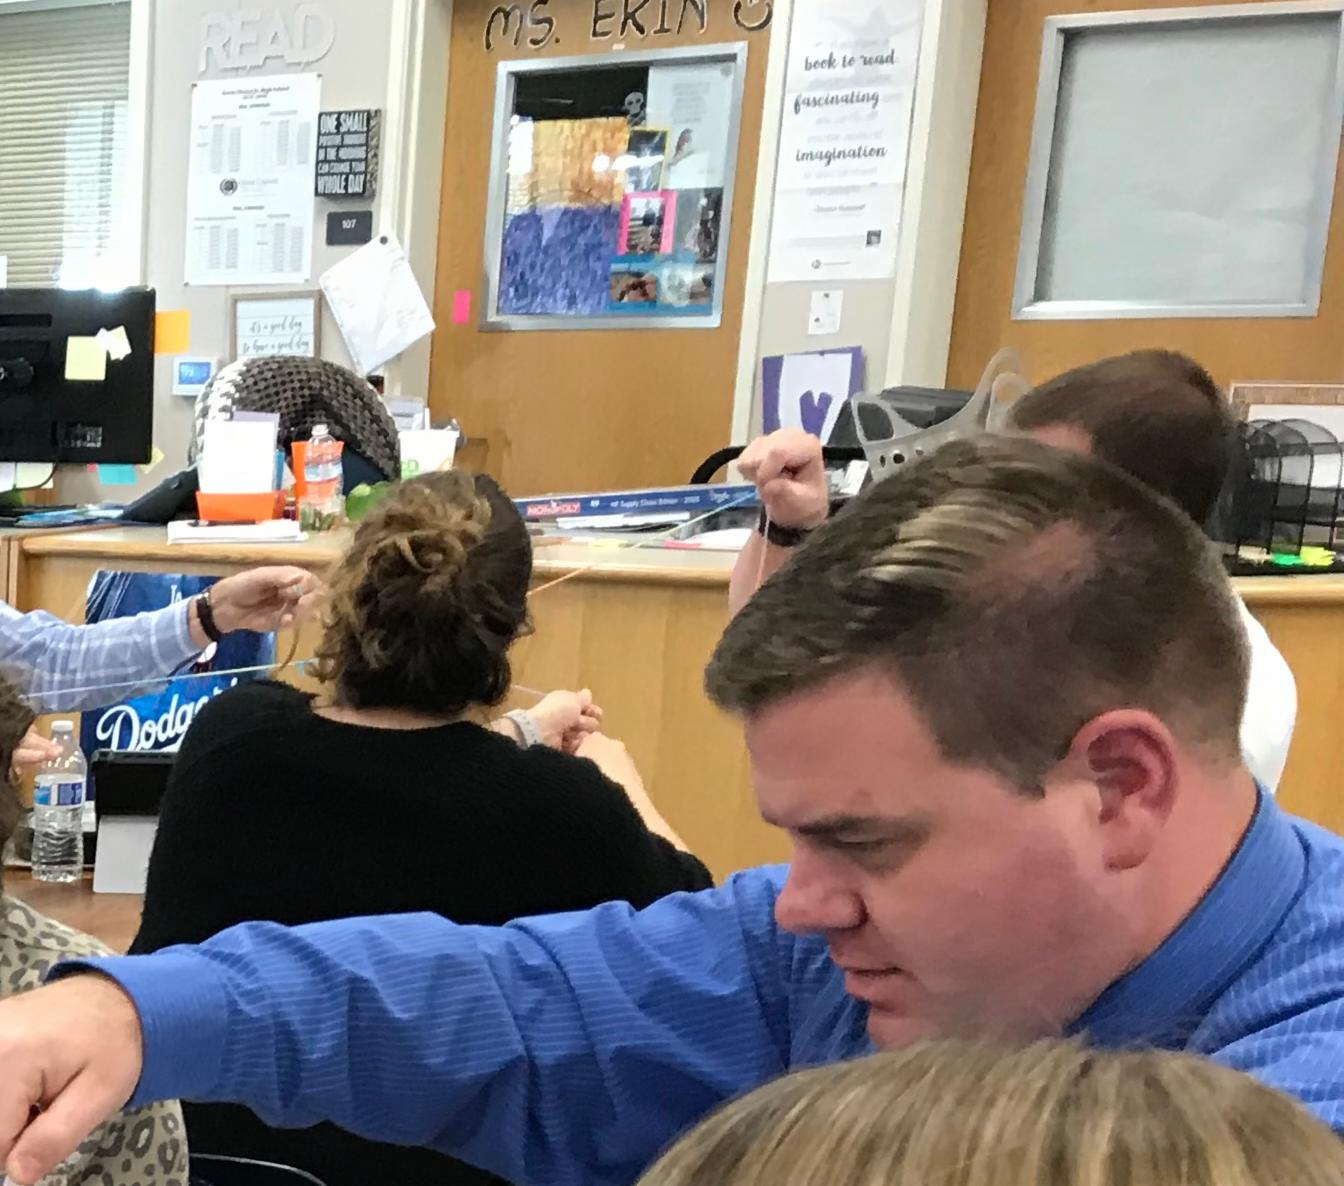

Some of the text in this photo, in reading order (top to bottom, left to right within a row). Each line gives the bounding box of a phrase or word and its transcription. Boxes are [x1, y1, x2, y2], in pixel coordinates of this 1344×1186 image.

[484, 0, 561, 50] MS.
[198, 4, 335, 72] READ
[804, 48, 896, 71] book to read
[794, 91, 880, 115] fascinating
[320, 112, 368, 134] ONE SMALL
[795, 145, 888, 167] imagination
[317, 174, 365, 194] WHOLE DAY
[527, 502, 581, 516] MONOPOLY
[96, 677, 239, 751] Dodg
